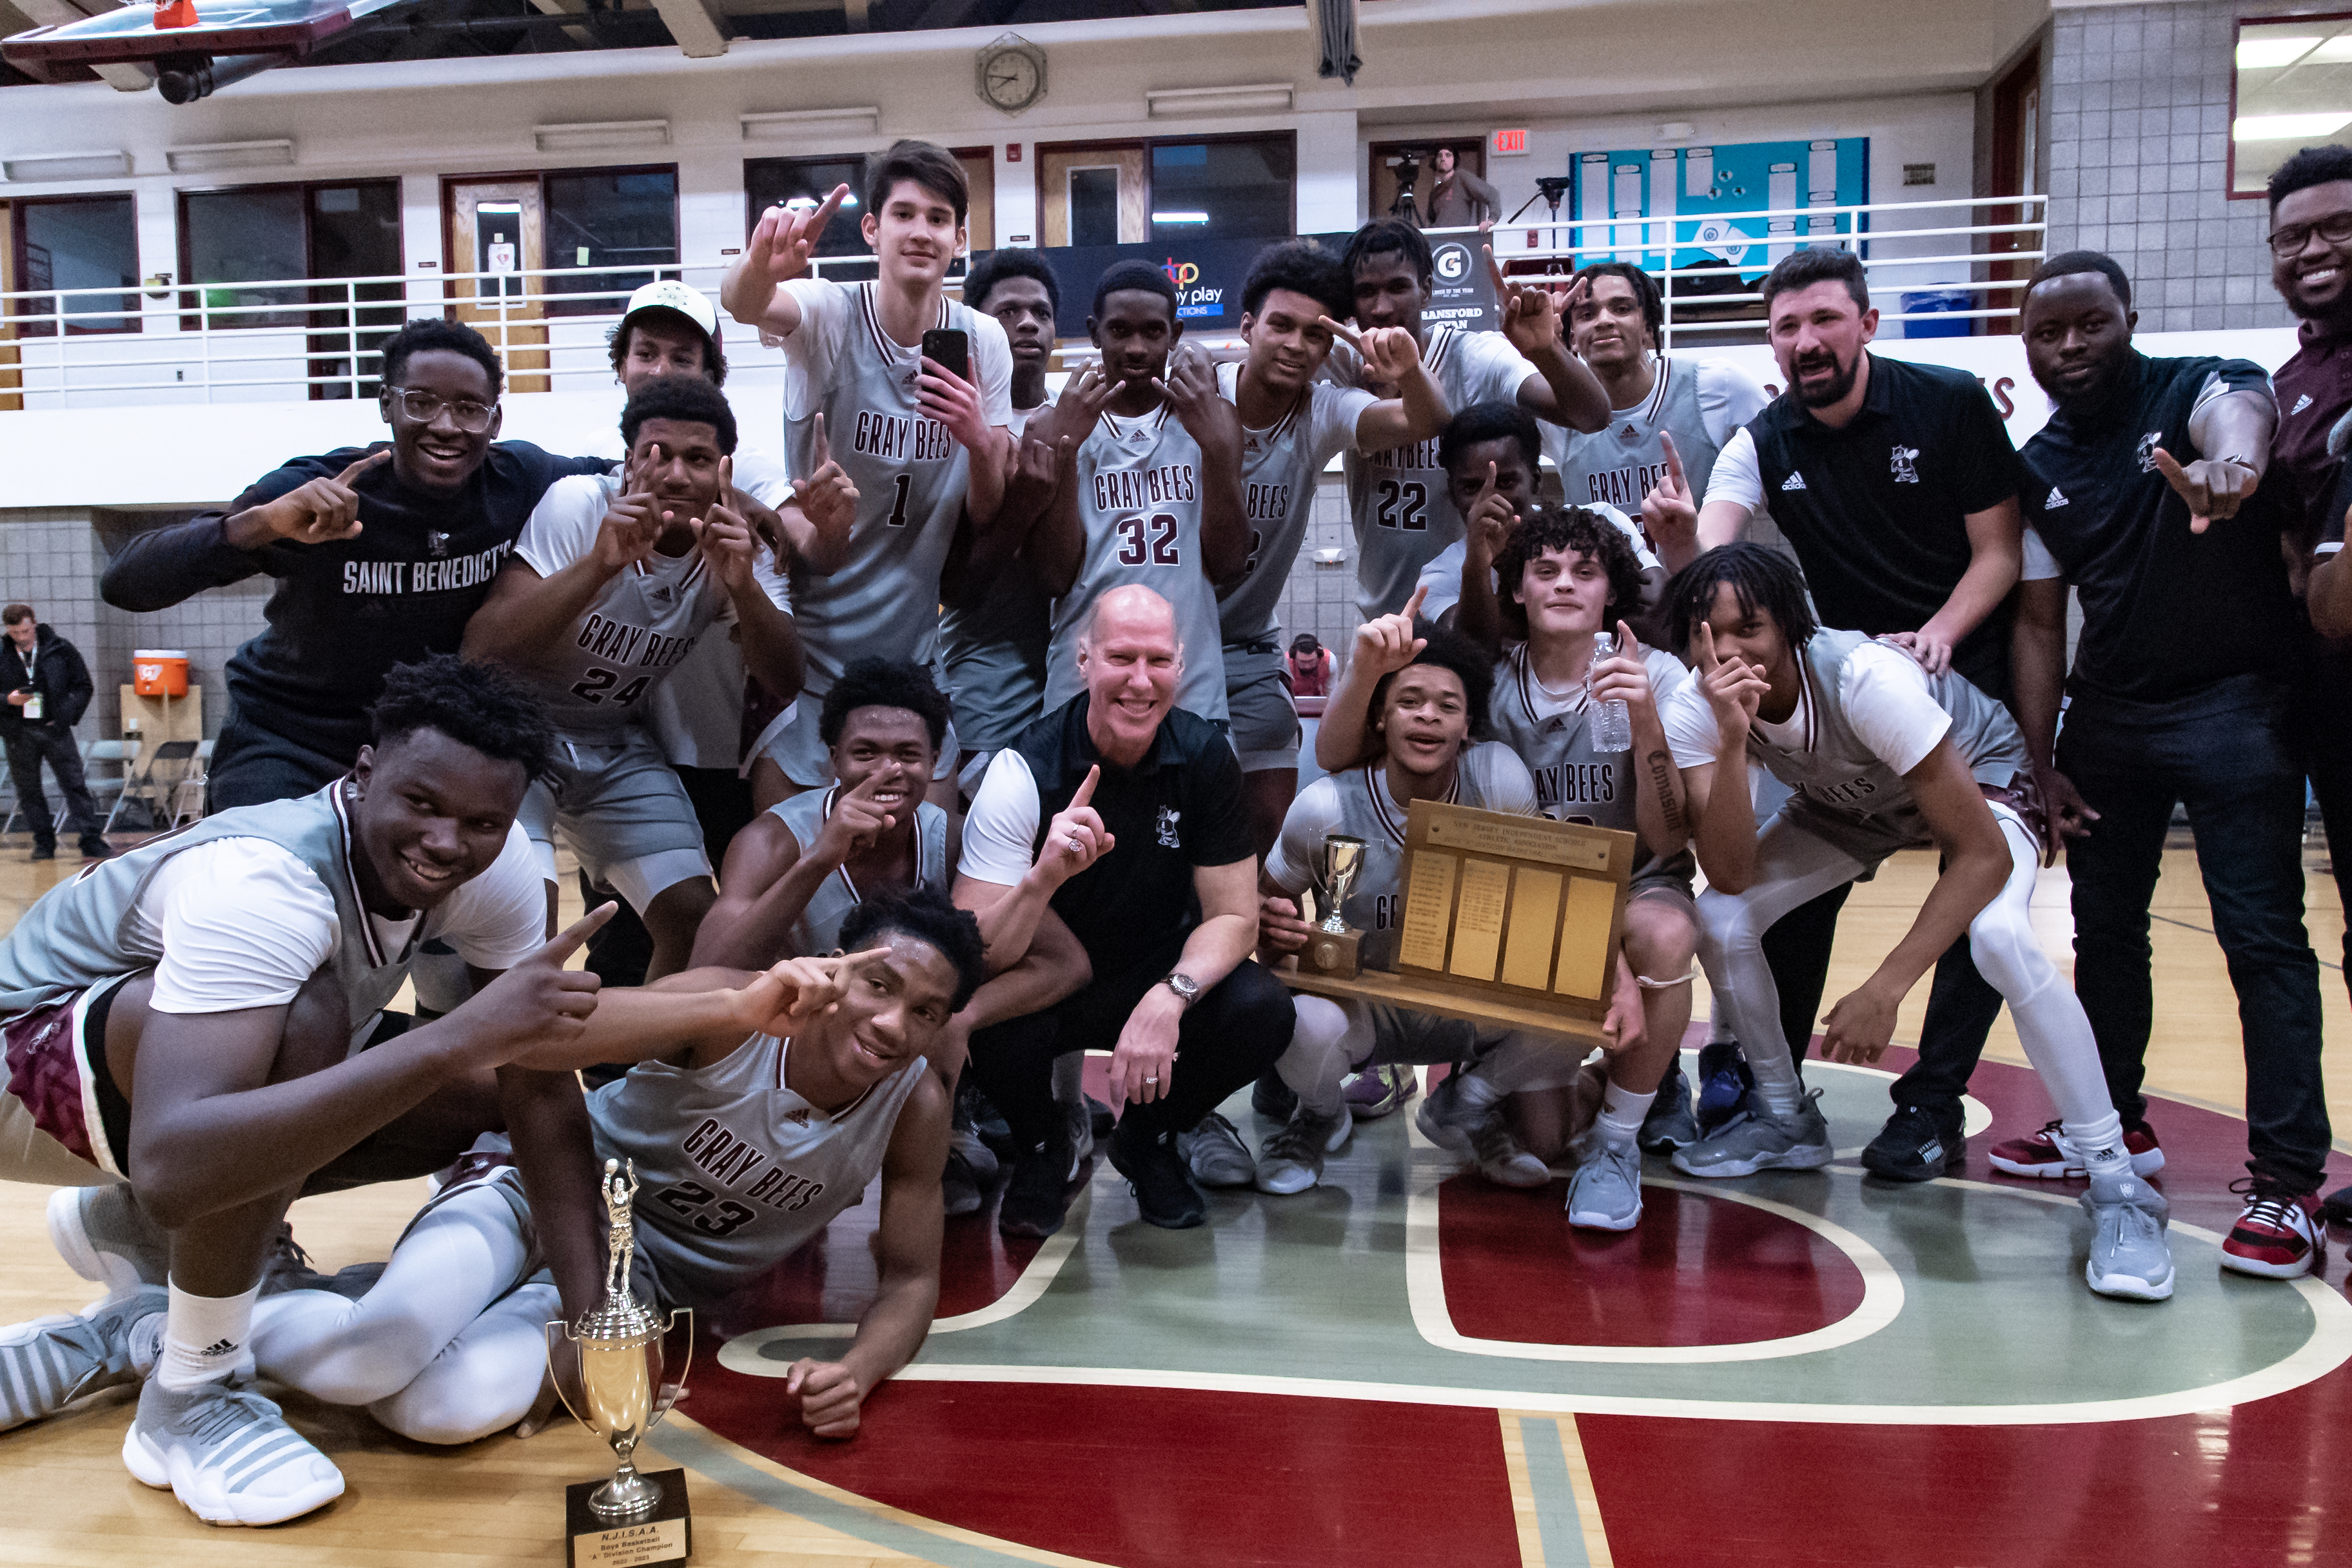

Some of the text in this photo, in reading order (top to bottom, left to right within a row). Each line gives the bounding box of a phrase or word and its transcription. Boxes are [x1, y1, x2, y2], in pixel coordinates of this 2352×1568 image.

[1498, 130, 1527, 151] EXIT
[1437, 251, 1462, 278] G
[1177, 306, 1208, 317] CTIONS
[1191, 286, 1223, 305] play
[854, 410, 952, 461] GRAY BEES
[887, 473, 912, 527] 1
[1094, 464, 1195, 514] GRAY BEES
[1247, 482, 1289, 520] BEES
[1377, 478, 1427, 531] 22
[1587, 467, 1632, 505] GRAY
[2044, 498, 2069, 510] adidas
[1116, 512, 1181, 567] 32
[343, 560, 407, 595] SAINT
[576, 612, 697, 668] GRAY BEES
[570, 666, 654, 709] 24
[1534, 762, 1614, 804] AY BEES
[1473, 824, 1499, 834] JERSEY
[1502, 828, 1552, 841] INDEPENDENT
[1555, 836, 1586, 847] SCHOOLS
[1478, 833, 1558, 850] ATHLETIC ASSOCIATION
[681, 1117, 825, 1212] GRAY BEES
[652, 1179, 758, 1237] 23
[200, 1344, 239, 1357] adidas
[603, 1549, 634, 1558] Division
[636, 1543, 673, 1553] Champion
[622, 1536, 660, 1548] Basketball
